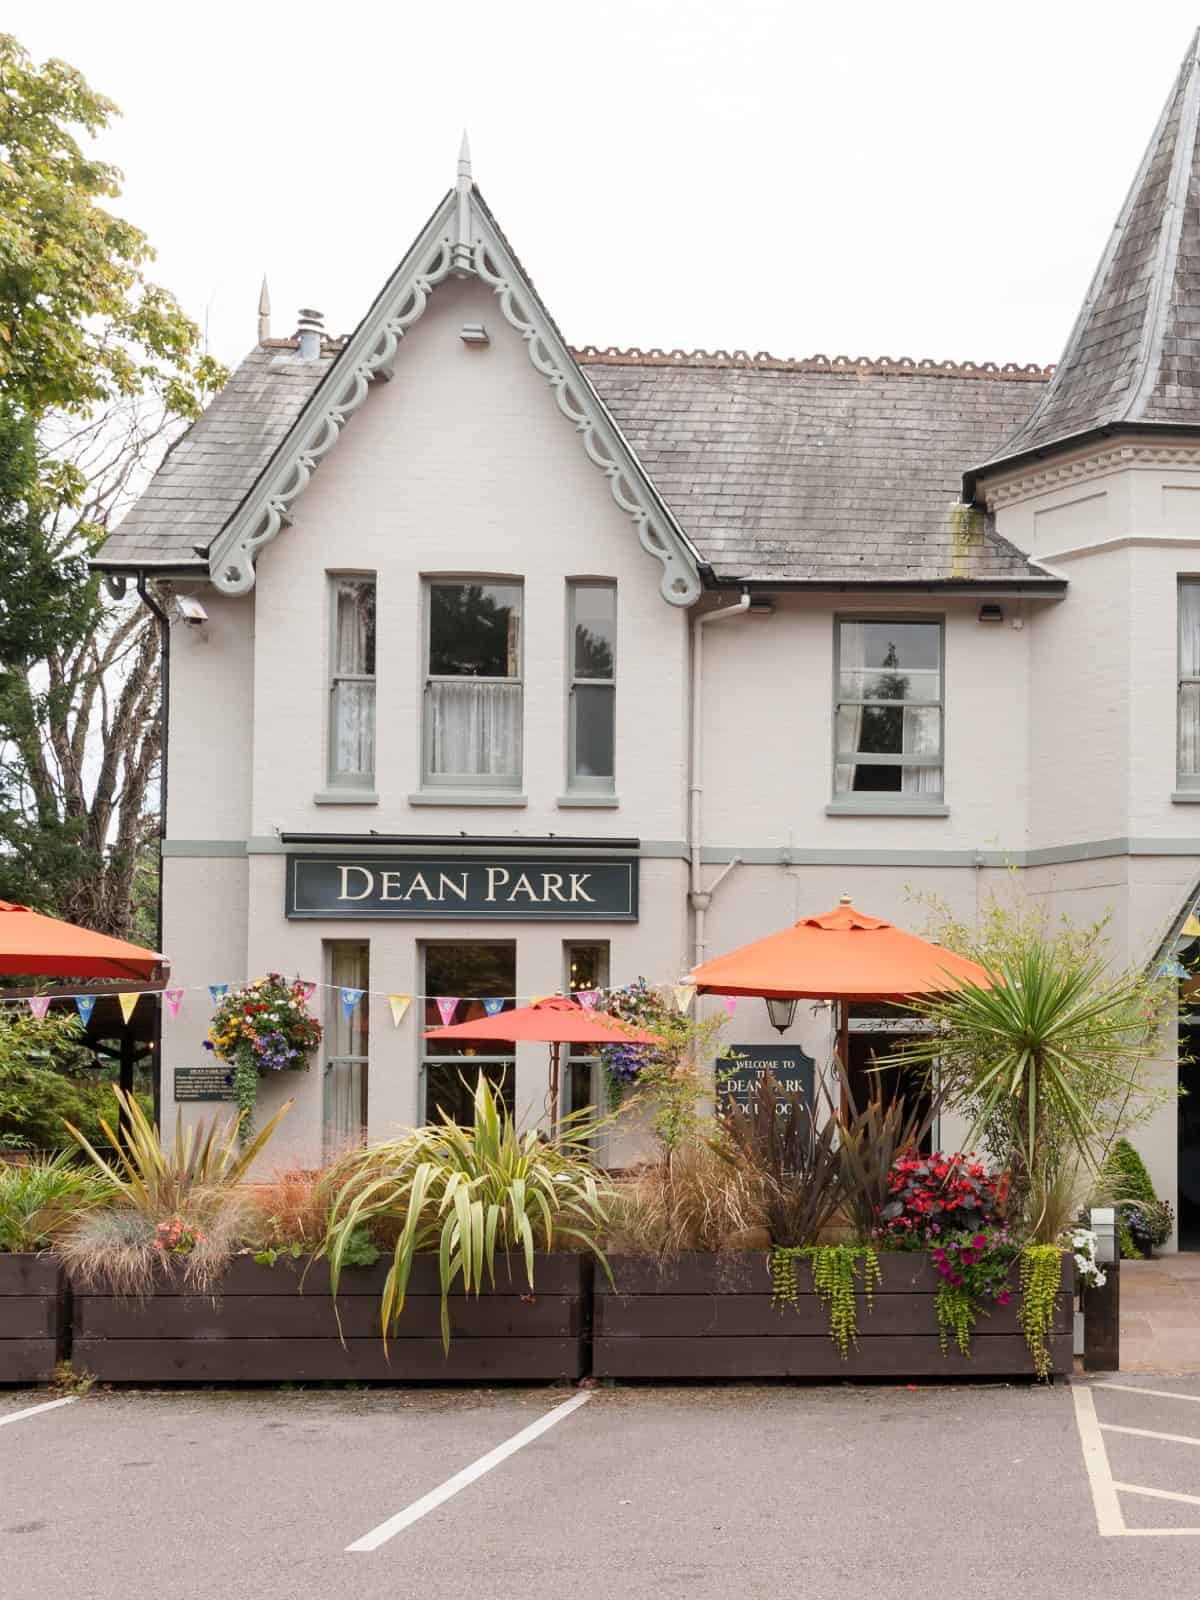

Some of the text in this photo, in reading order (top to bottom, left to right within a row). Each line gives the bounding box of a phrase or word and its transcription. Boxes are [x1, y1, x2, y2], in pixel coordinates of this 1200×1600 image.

[336, 865, 597, 903] DEAN PARK
[783, 1060, 796, 1069] TO
[773, 1080, 805, 1092] ARK
